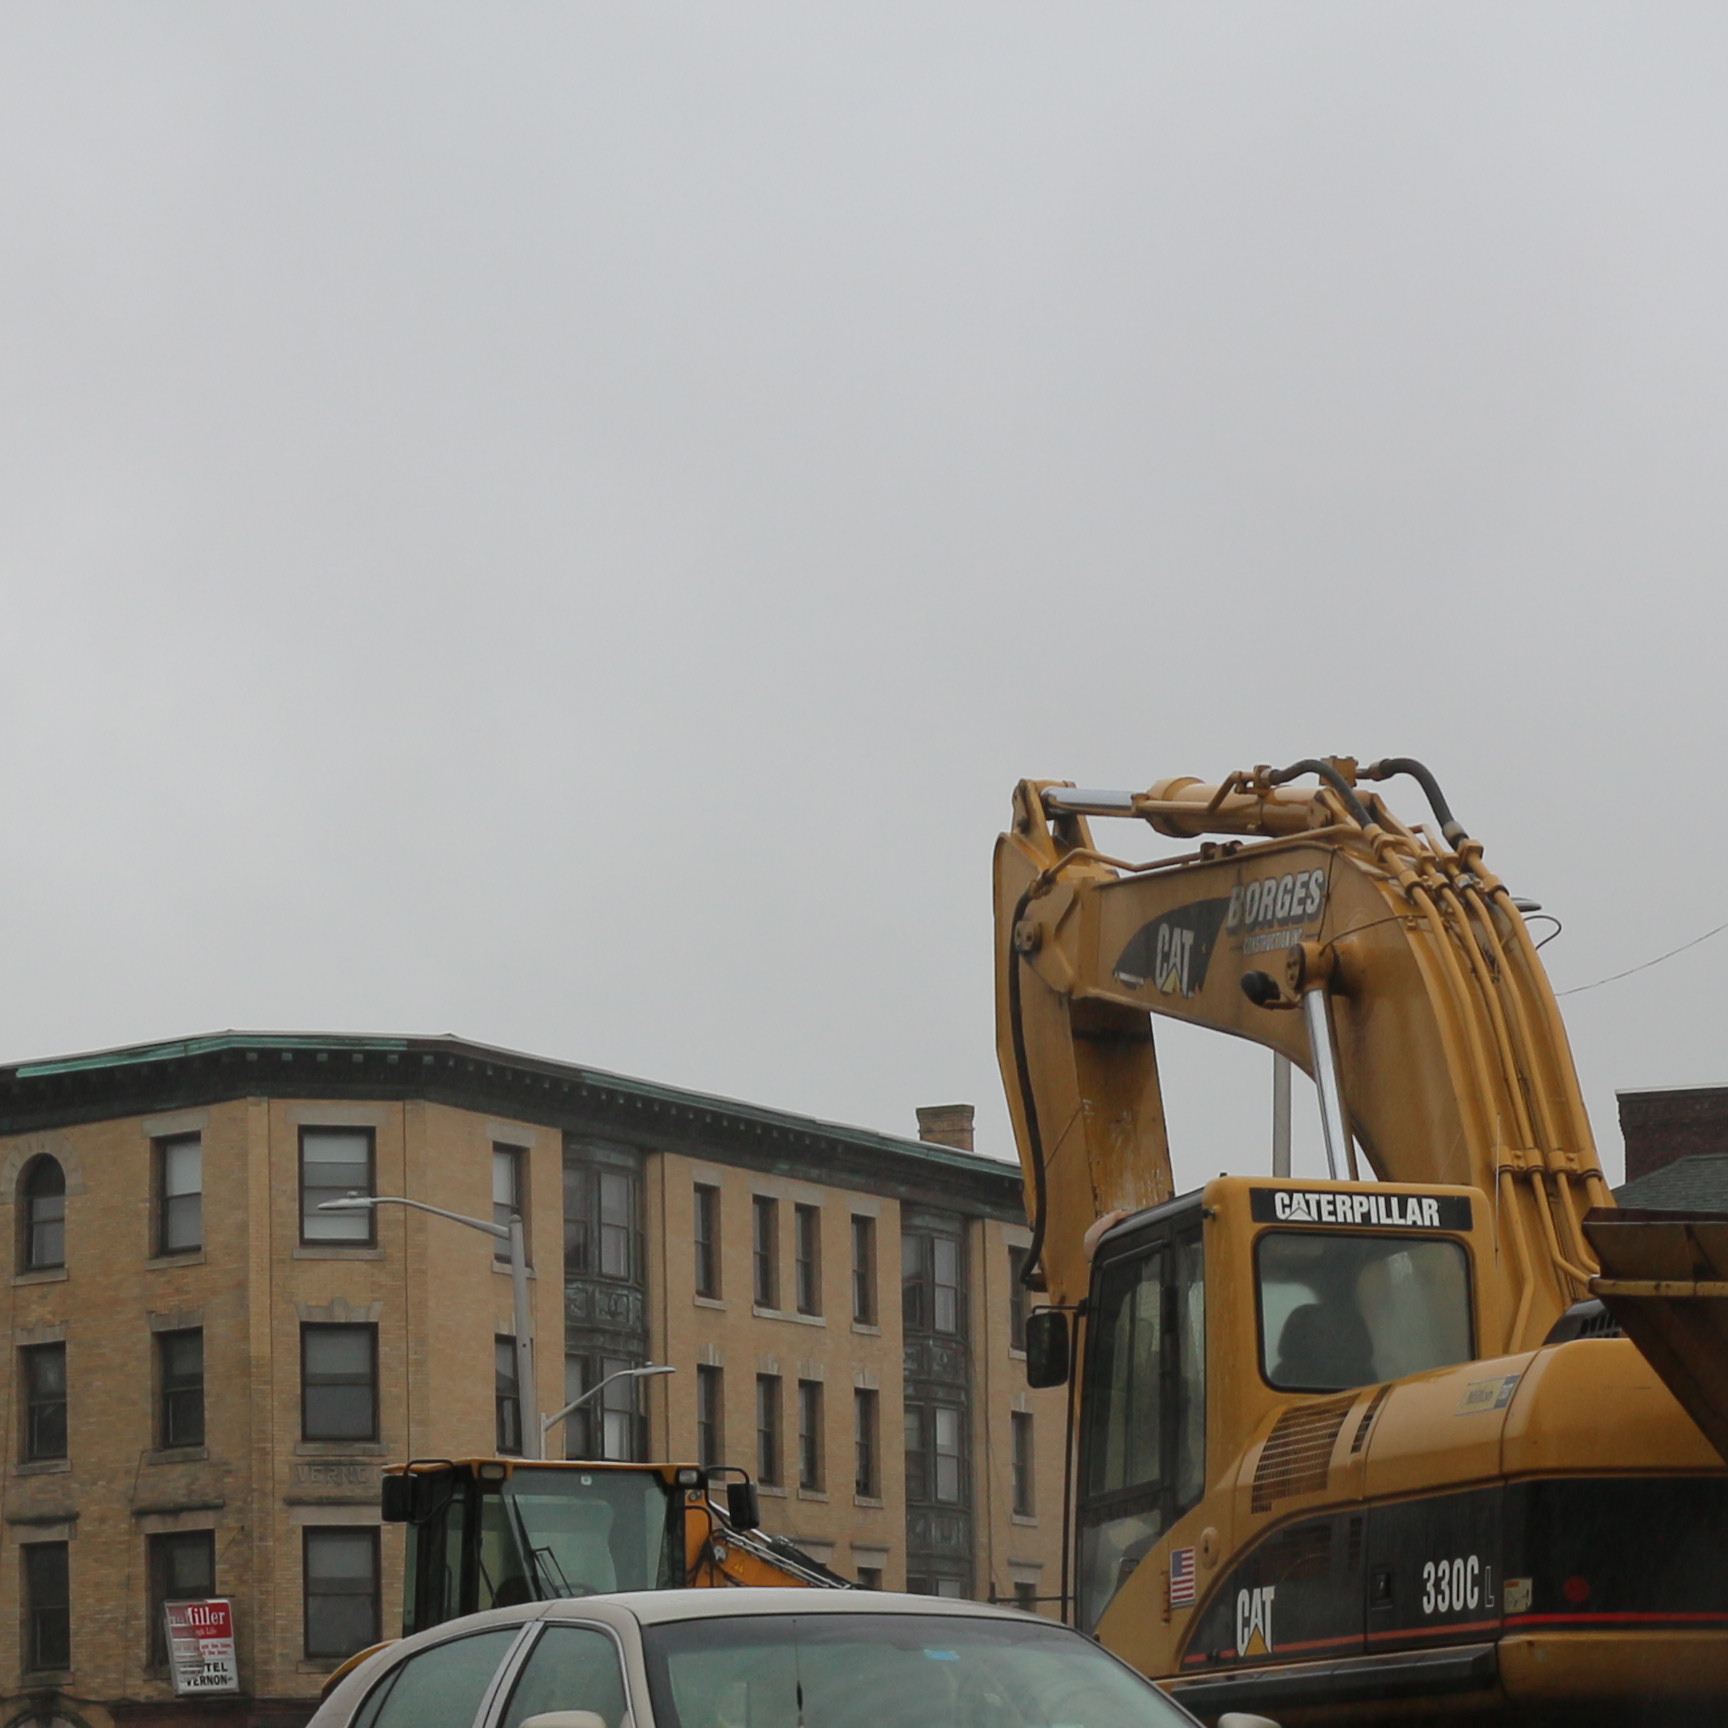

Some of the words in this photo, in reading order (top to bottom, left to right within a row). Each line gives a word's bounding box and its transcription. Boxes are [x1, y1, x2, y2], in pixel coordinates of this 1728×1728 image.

[1226, 868, 1326, 932] BORGES
[1154, 922, 1196, 999] CAT
[1274, 1191, 1441, 1227] CATERPILLAR
[1422, 1555, 1480, 1615] 330C
[1484, 1566, 1495, 1608] L
[1236, 1585, 1276, 1657] CAT
[203, 1662, 228, 1673] TEL
